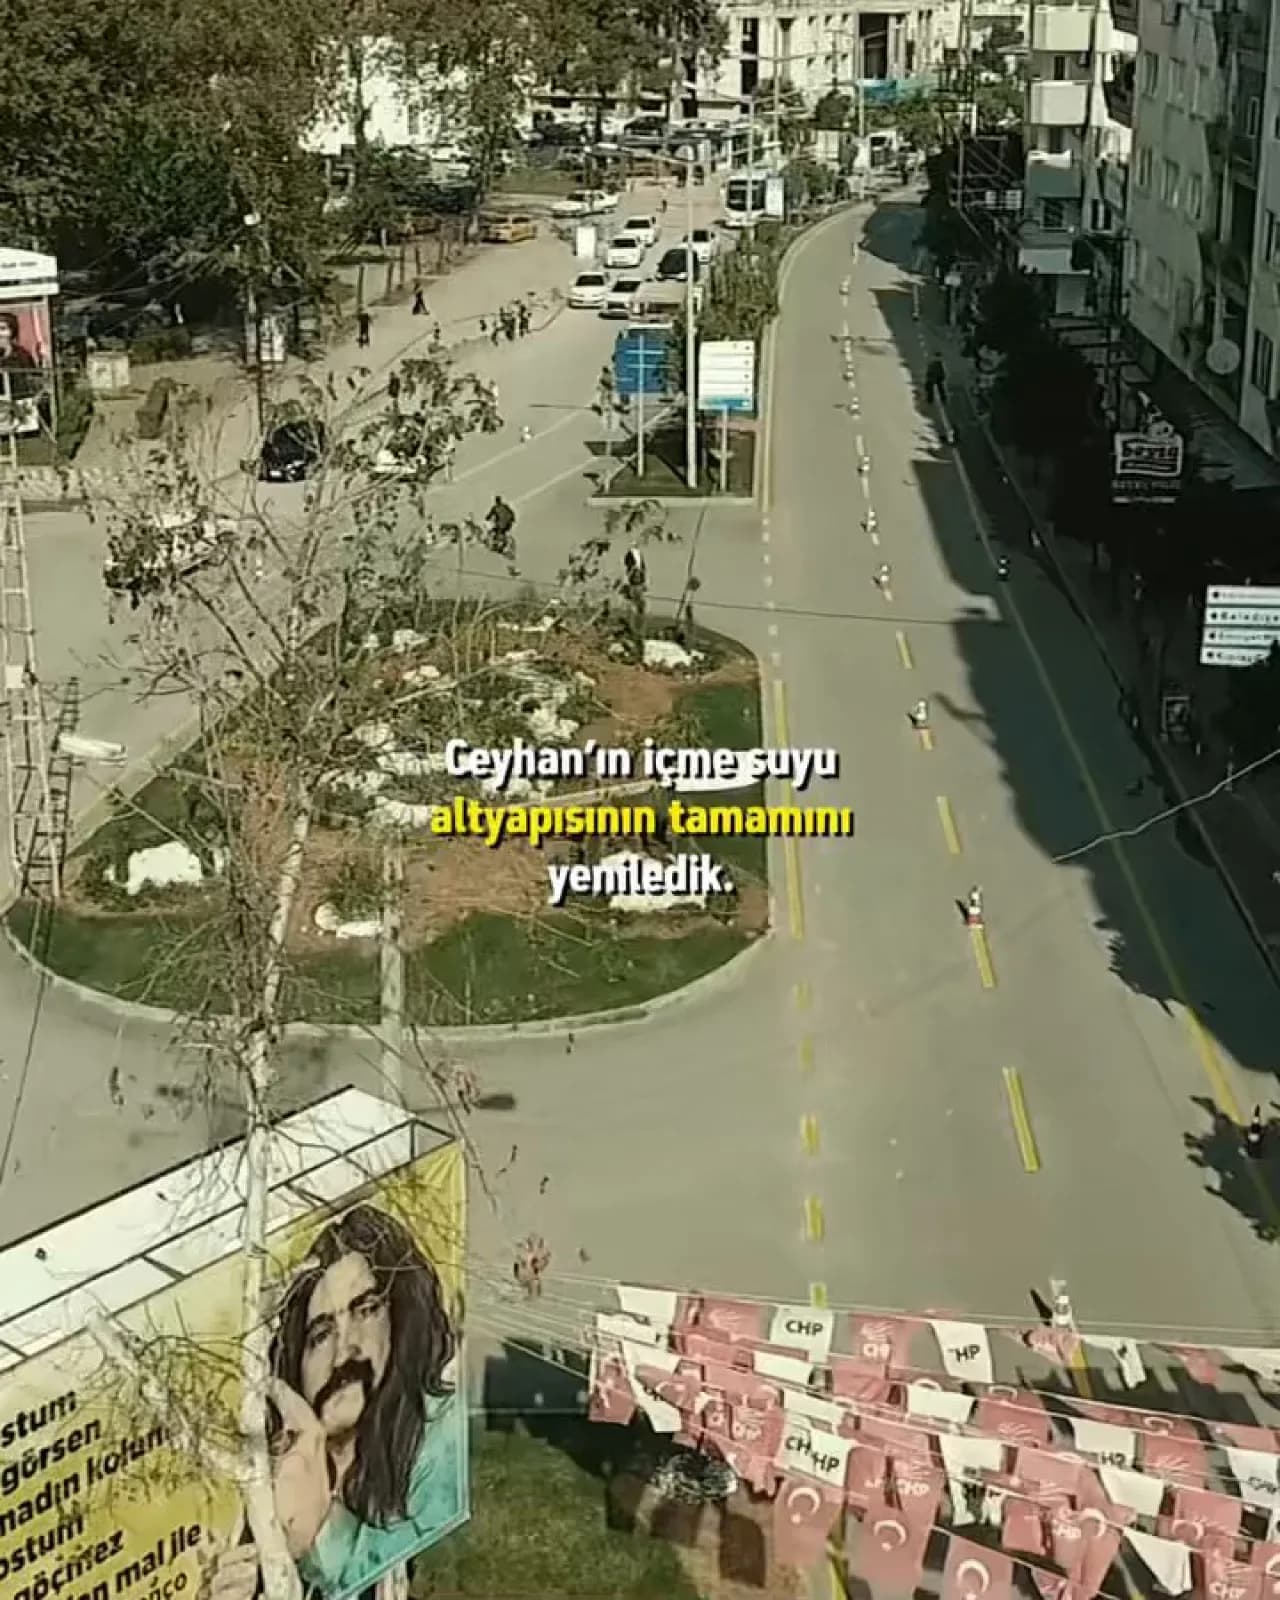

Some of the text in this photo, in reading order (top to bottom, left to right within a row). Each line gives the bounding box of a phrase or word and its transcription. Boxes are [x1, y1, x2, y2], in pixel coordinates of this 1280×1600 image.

[785, 1320, 823, 1336] CHP
[947, 1343, 981, 1363] HP
[785, 1435, 812, 1454] CH
[1, 1419, 101, 1497] görsen
[812, 1451, 840, 1473] HP
[115, 1539, 165, 1594] mal
